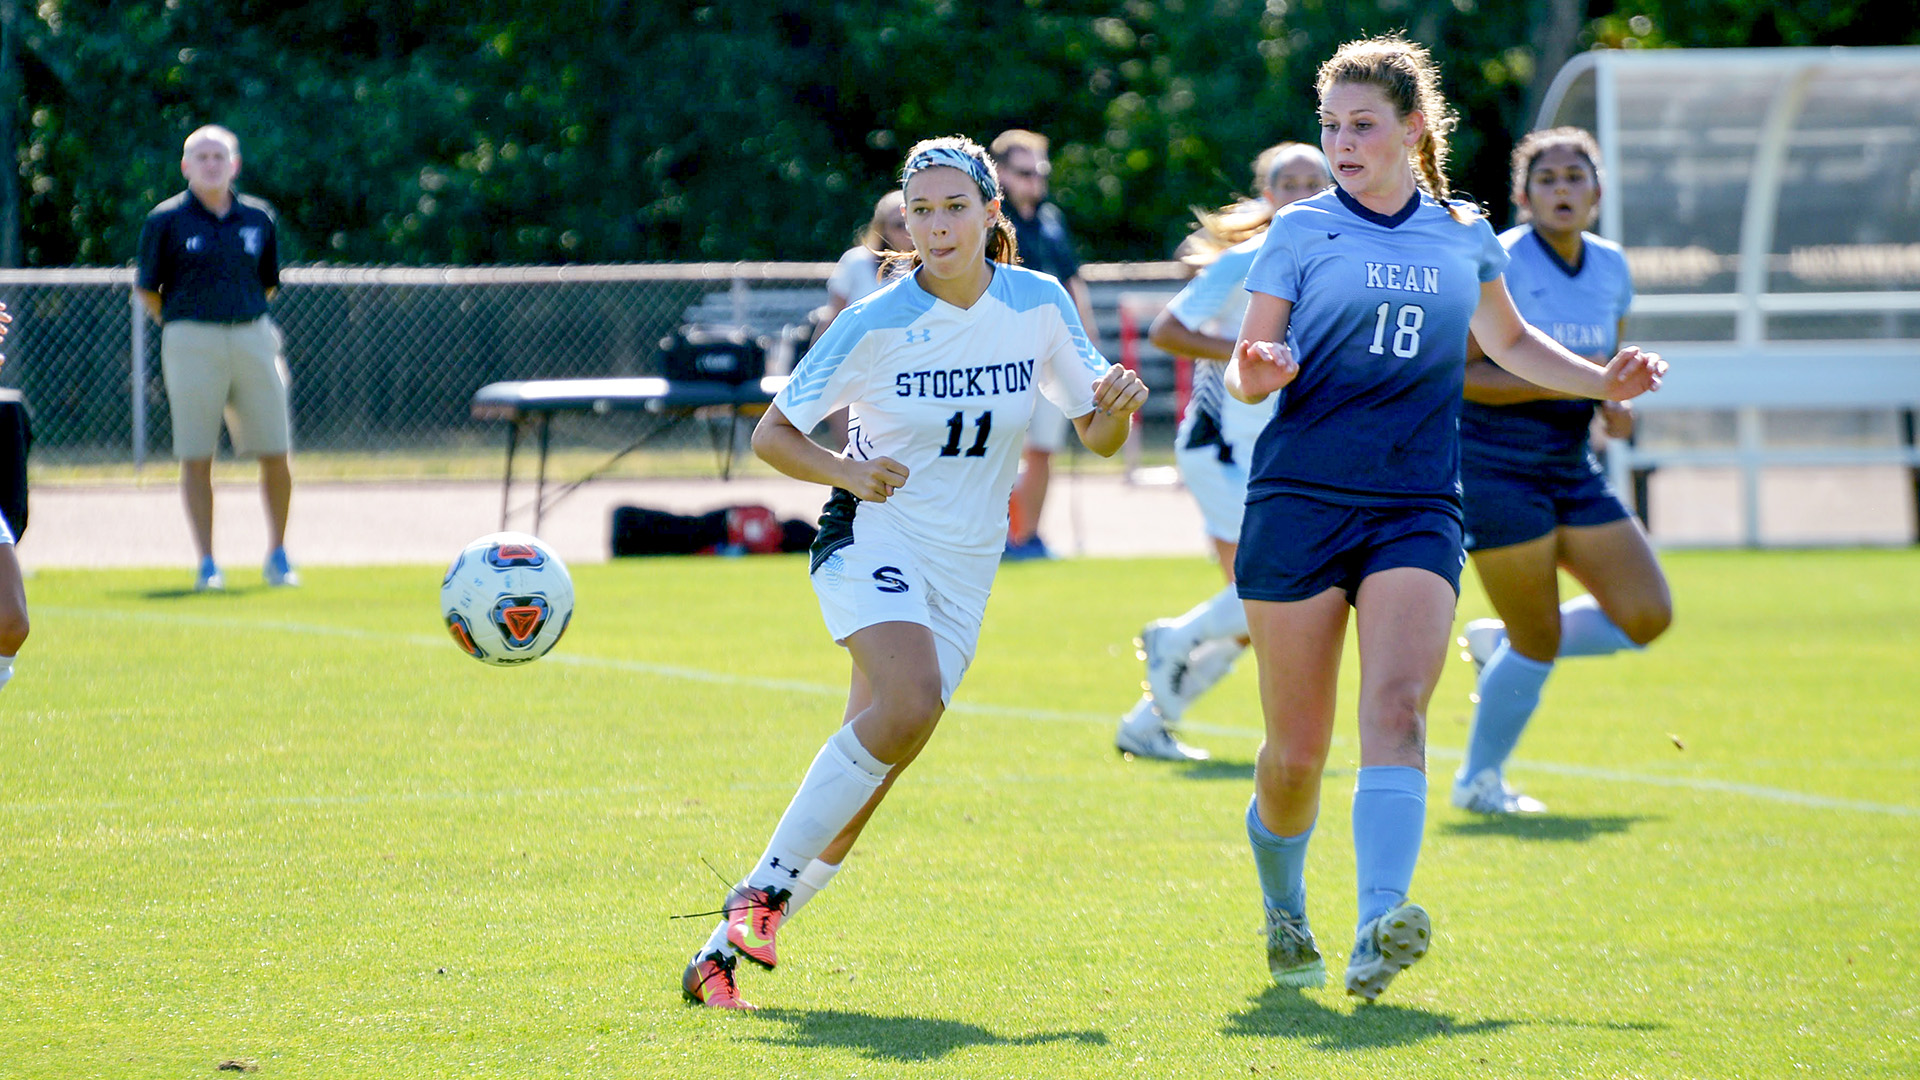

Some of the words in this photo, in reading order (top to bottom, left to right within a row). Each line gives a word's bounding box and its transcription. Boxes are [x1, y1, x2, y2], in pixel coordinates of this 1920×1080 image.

[1365, 262, 1439, 295] KEAN
[1368, 301, 1426, 359] 18
[1551, 322, 1606, 347] KEAN
[896, 358, 1035, 399] STOCKTON
[938, 410, 992, 458] 11
